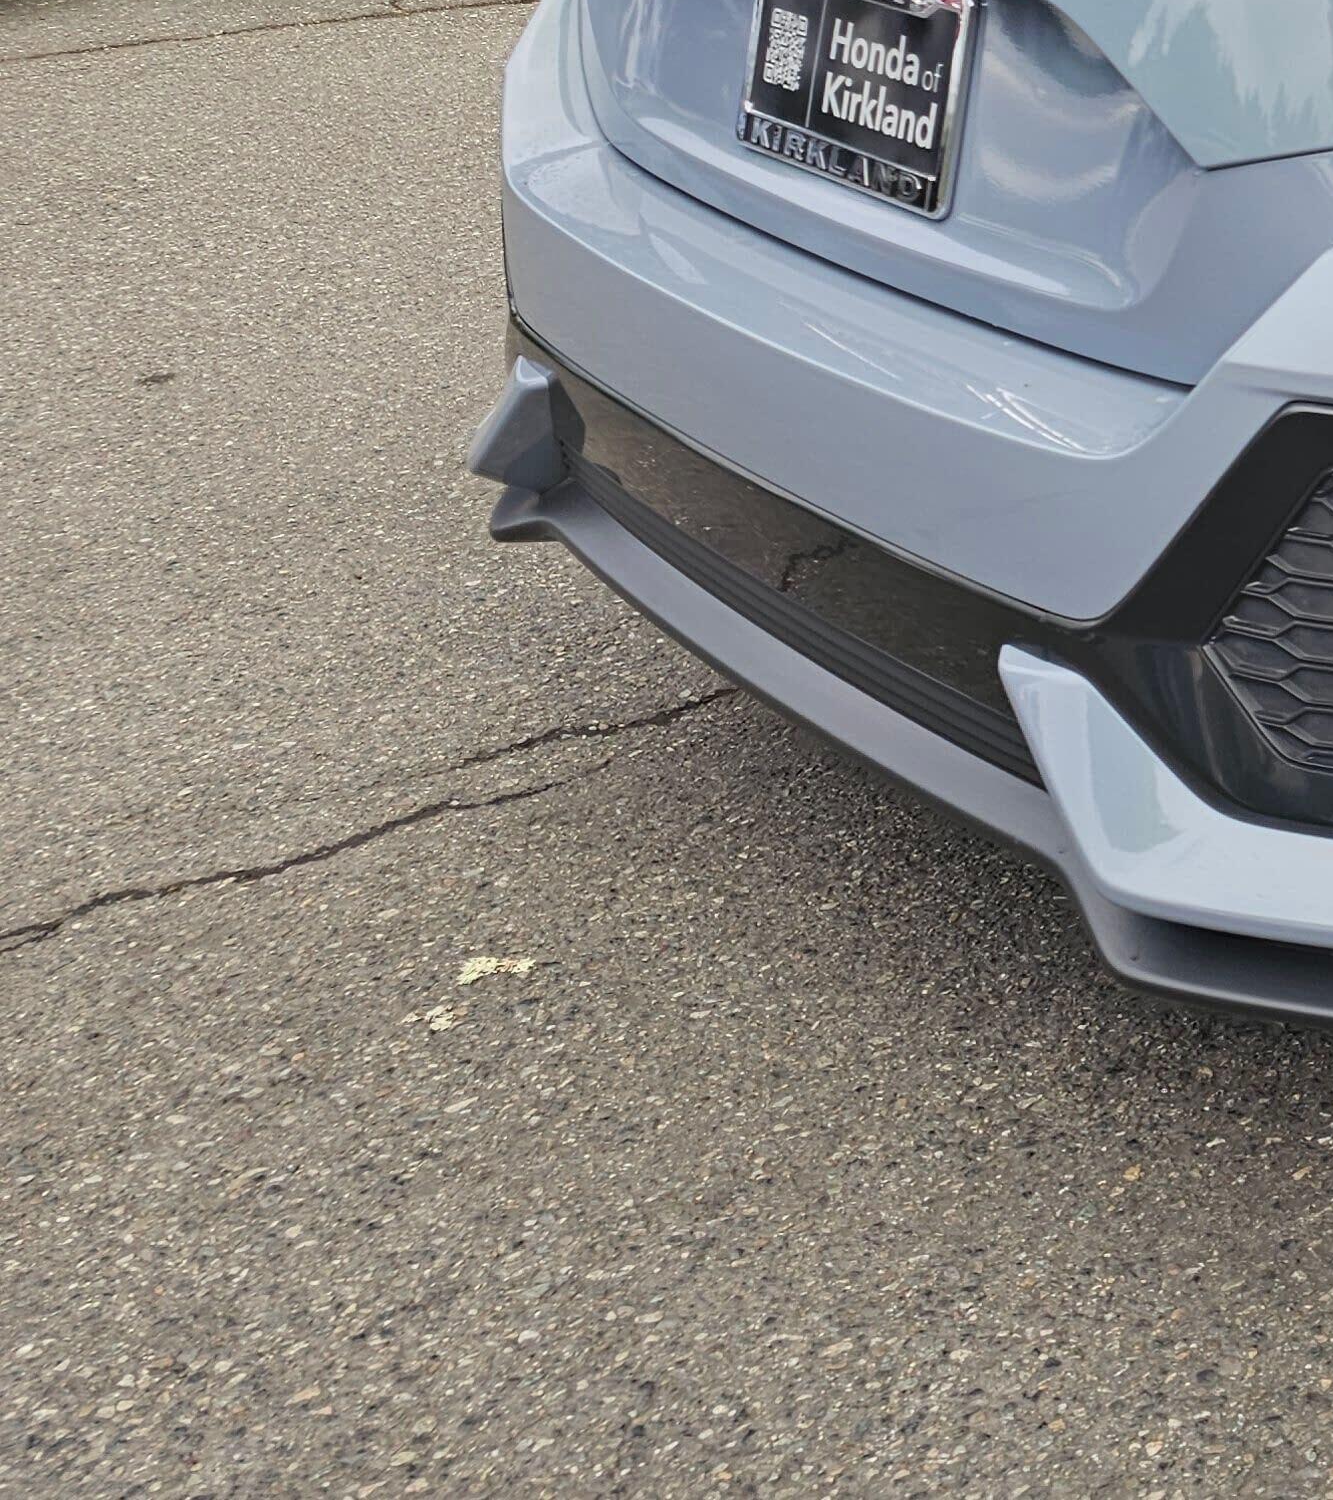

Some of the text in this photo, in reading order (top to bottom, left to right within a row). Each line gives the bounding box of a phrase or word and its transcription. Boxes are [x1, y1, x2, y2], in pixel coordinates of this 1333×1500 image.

[829, 17, 944, 93] Honda of
[821, 71, 938, 150] Kirkland
